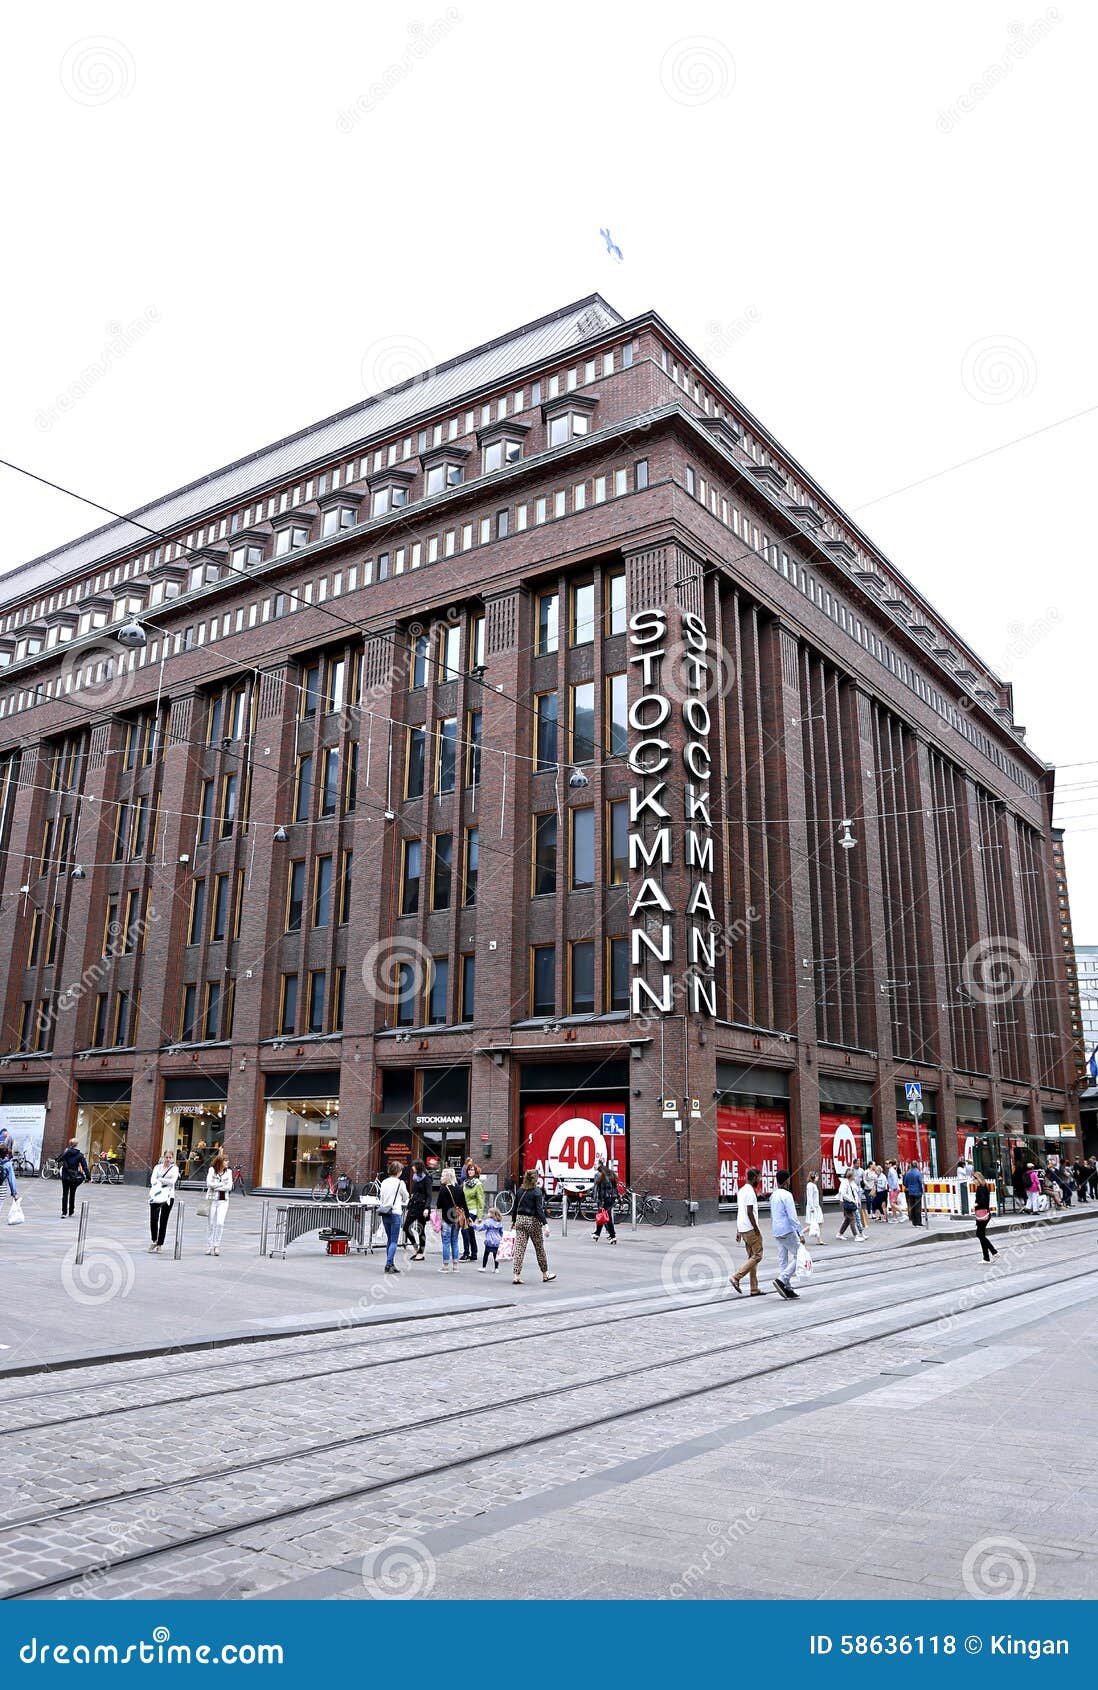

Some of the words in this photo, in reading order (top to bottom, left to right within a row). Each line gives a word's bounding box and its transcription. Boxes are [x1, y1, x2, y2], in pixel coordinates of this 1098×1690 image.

[628, 608, 673, 1016] STOCKMANN
[682, 612, 717, 1018] STOCKMANN
[416, 1115, 463, 1124] STOCKMANN
[721, 1160, 739, 1177] ALE
